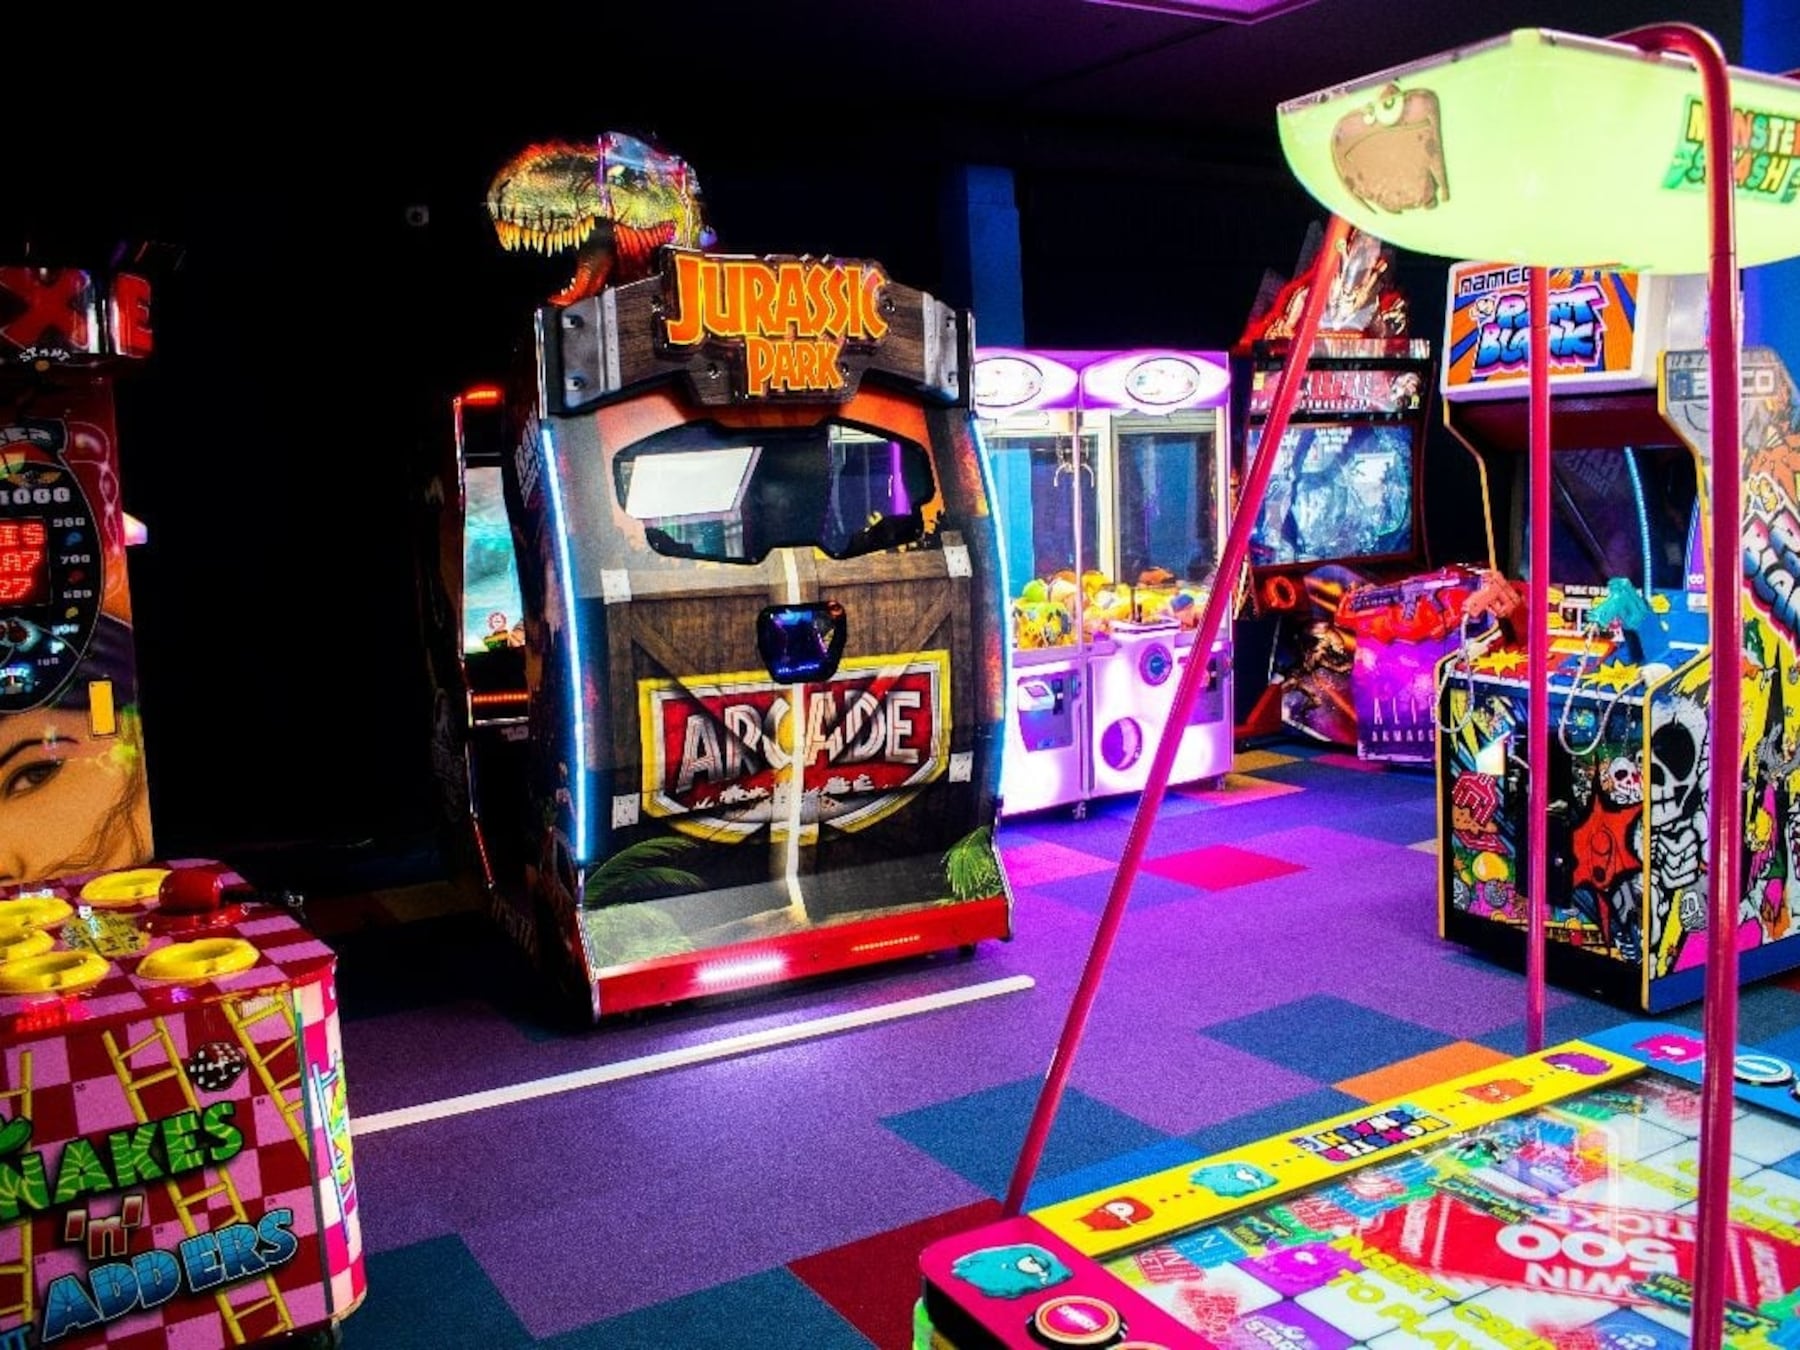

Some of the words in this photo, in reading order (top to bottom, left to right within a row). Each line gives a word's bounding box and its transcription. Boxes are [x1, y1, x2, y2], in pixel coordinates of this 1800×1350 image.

[1686, 100, 1800, 156] MNSTE
[1685, 144, 1790, 193] SASH
[668, 253, 888, 345] JURASSIC
[1495, 284, 1608, 328] PONT
[747, 338, 844, 396] PARK
[675, 690, 920, 793] ARCADE
[42, 1208, 298, 1342] ADDERS
[1495, 1222, 1680, 1276] 500
